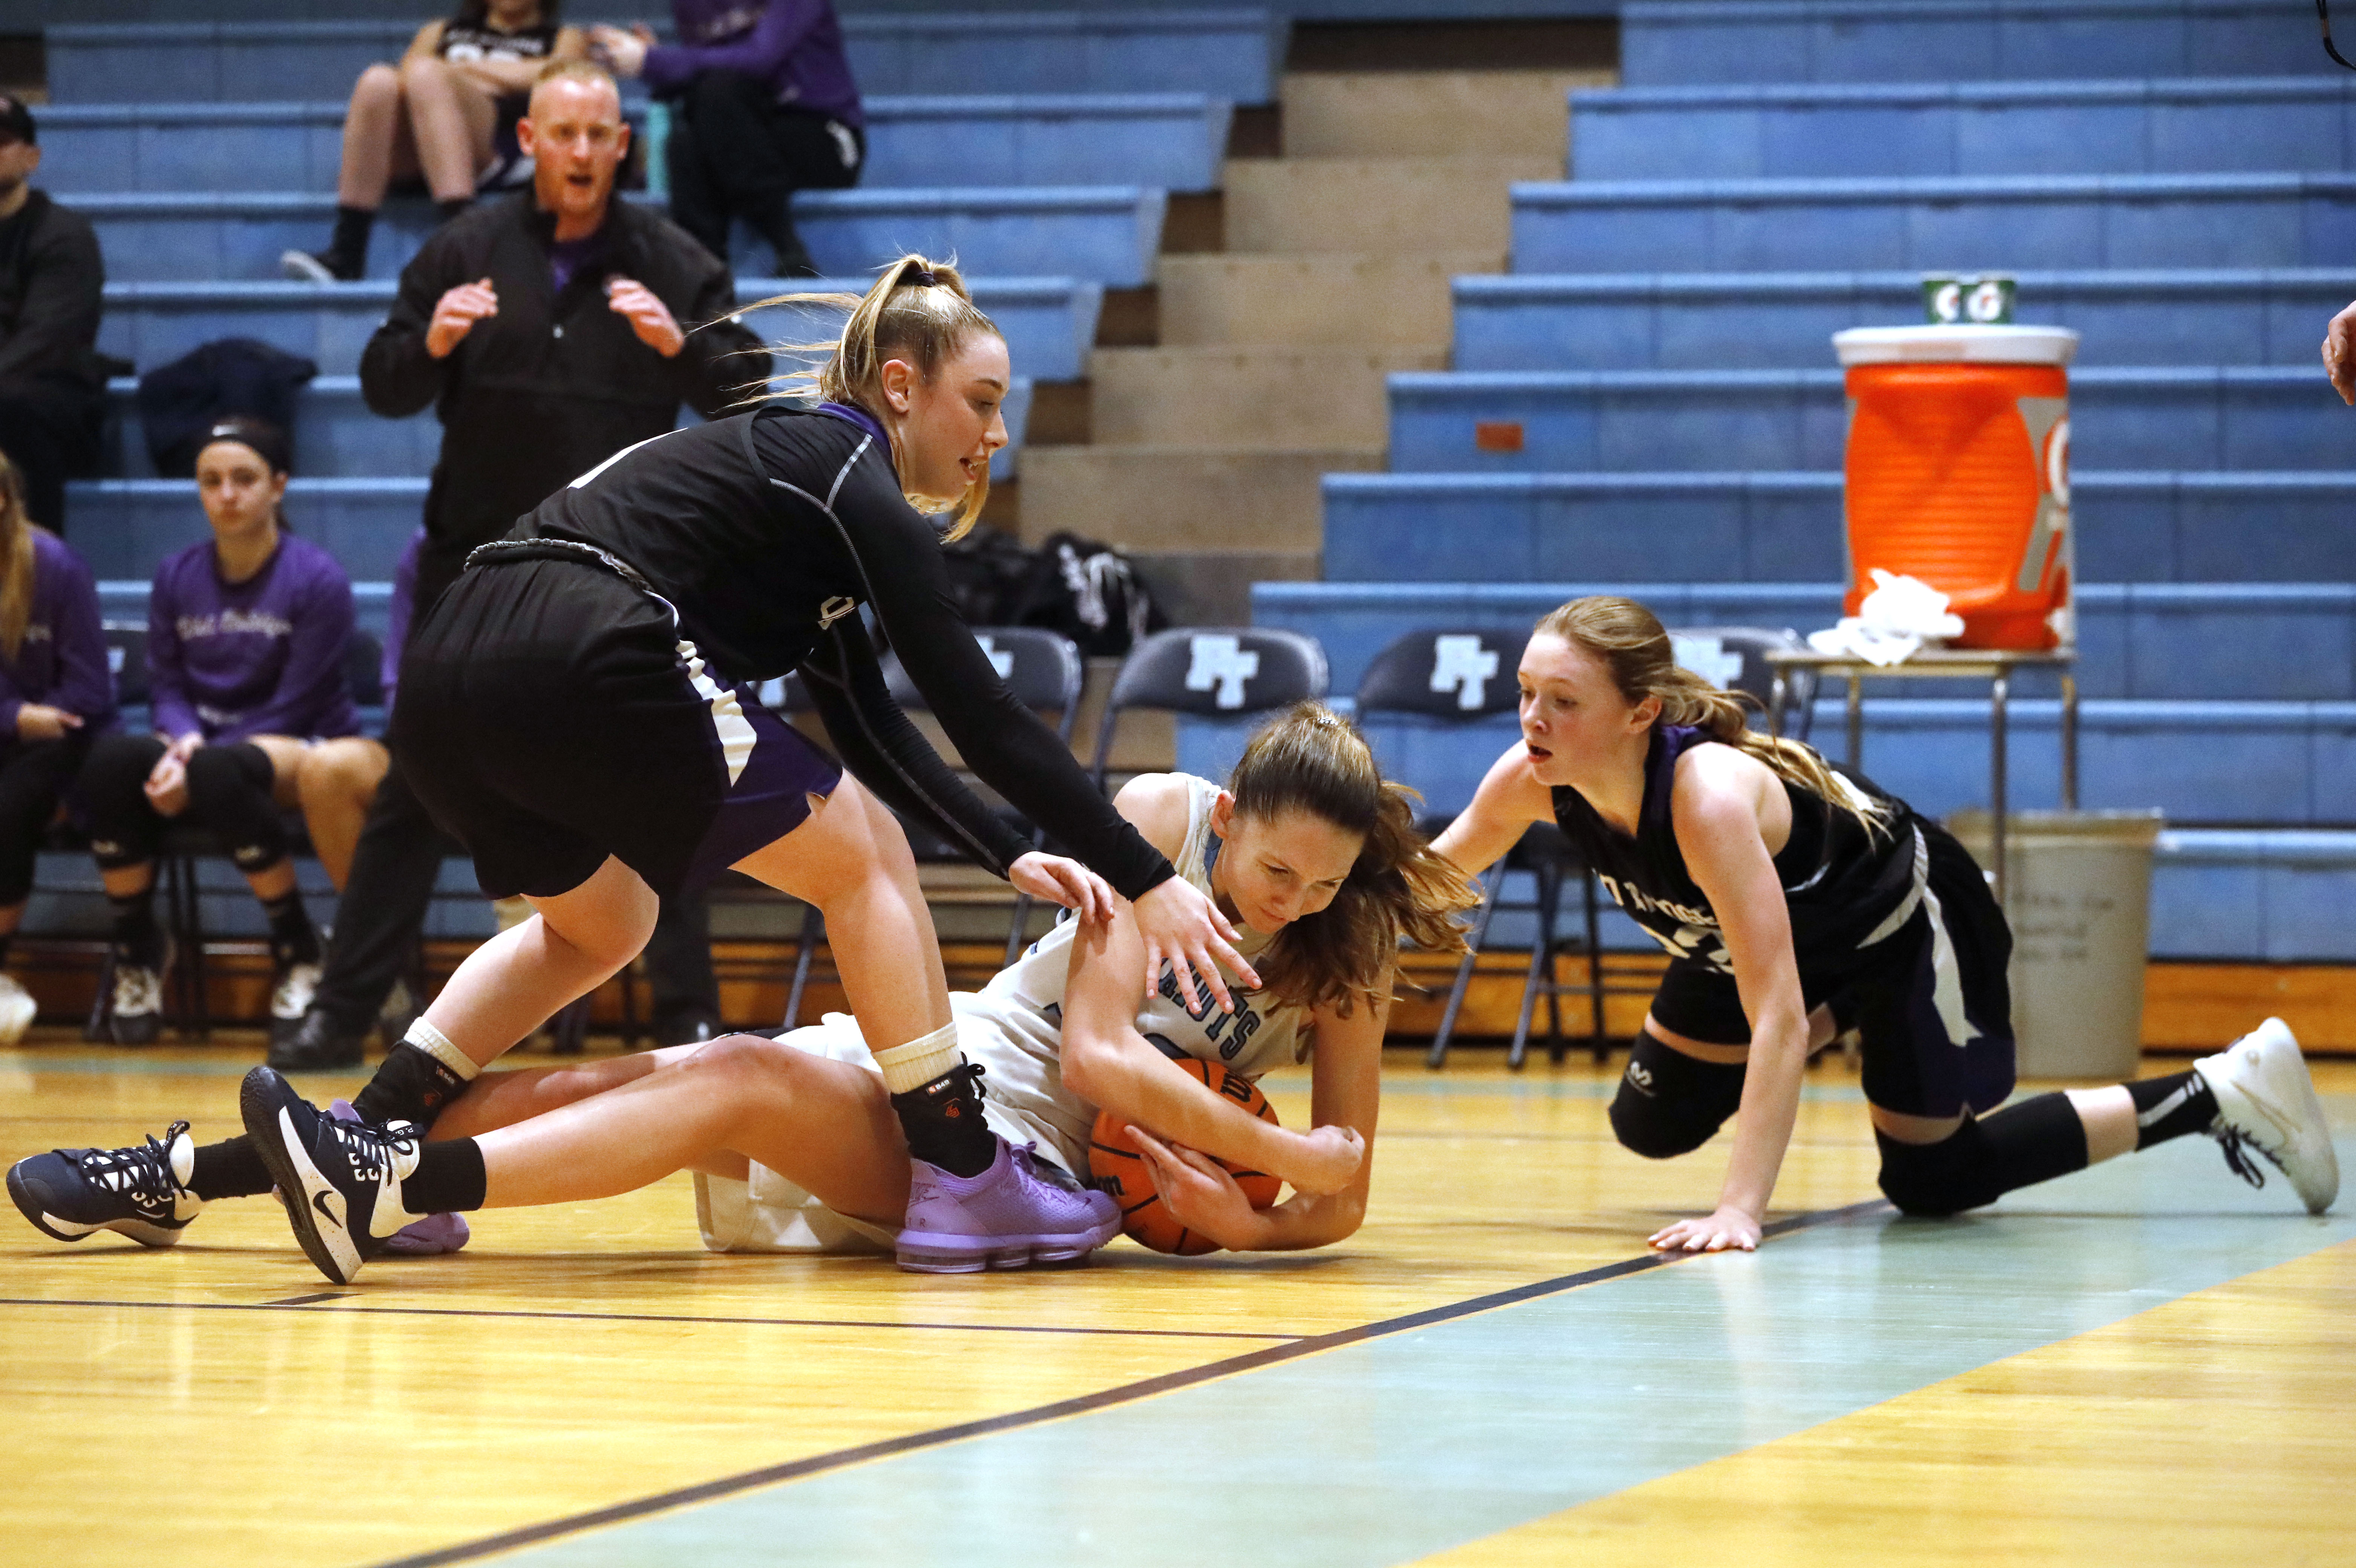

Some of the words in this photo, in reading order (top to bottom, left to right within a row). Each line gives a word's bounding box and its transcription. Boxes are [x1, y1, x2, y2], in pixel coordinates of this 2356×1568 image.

[1185, 634, 1259, 709] PT
[1430, 634, 1500, 710] PT
[909, 1217, 926, 1227] IR
